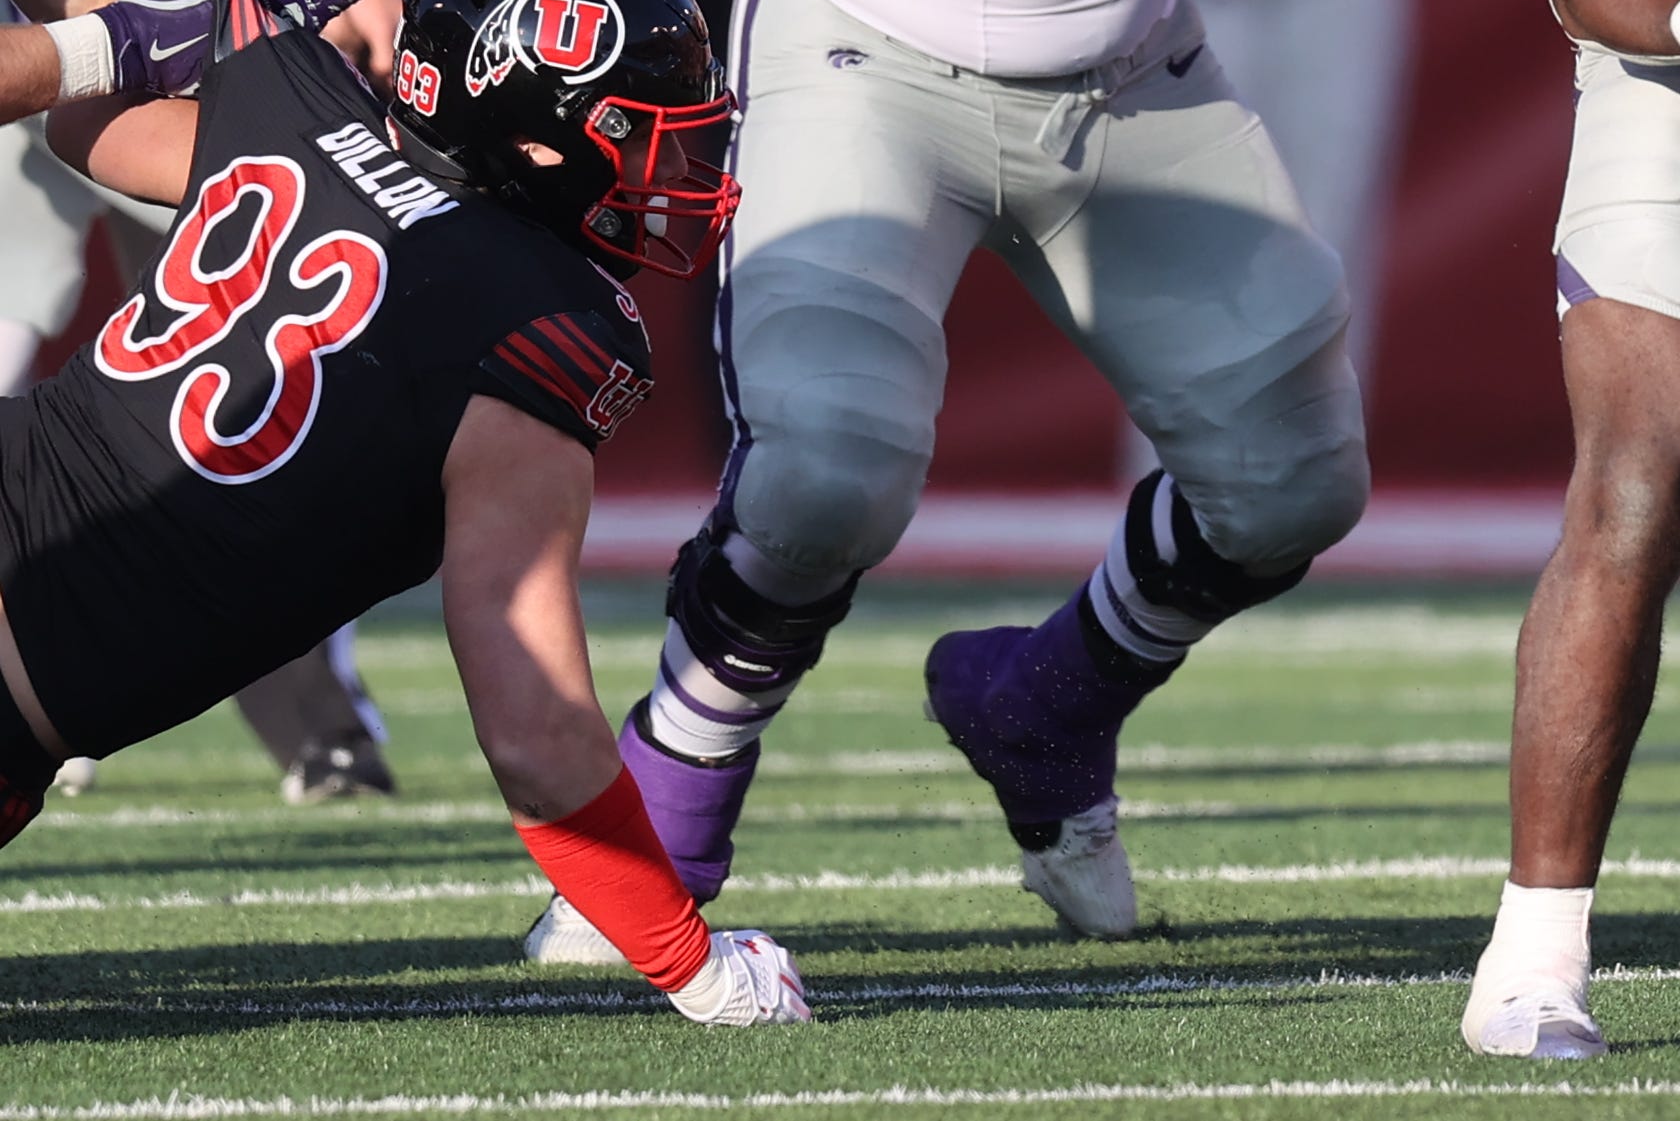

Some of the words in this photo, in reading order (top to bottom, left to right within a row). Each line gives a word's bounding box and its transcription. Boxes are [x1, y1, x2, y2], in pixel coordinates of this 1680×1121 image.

[397, 48, 442, 117] 93
[315, 121, 461, 231] DILLON
[93, 155, 389, 485] 93
